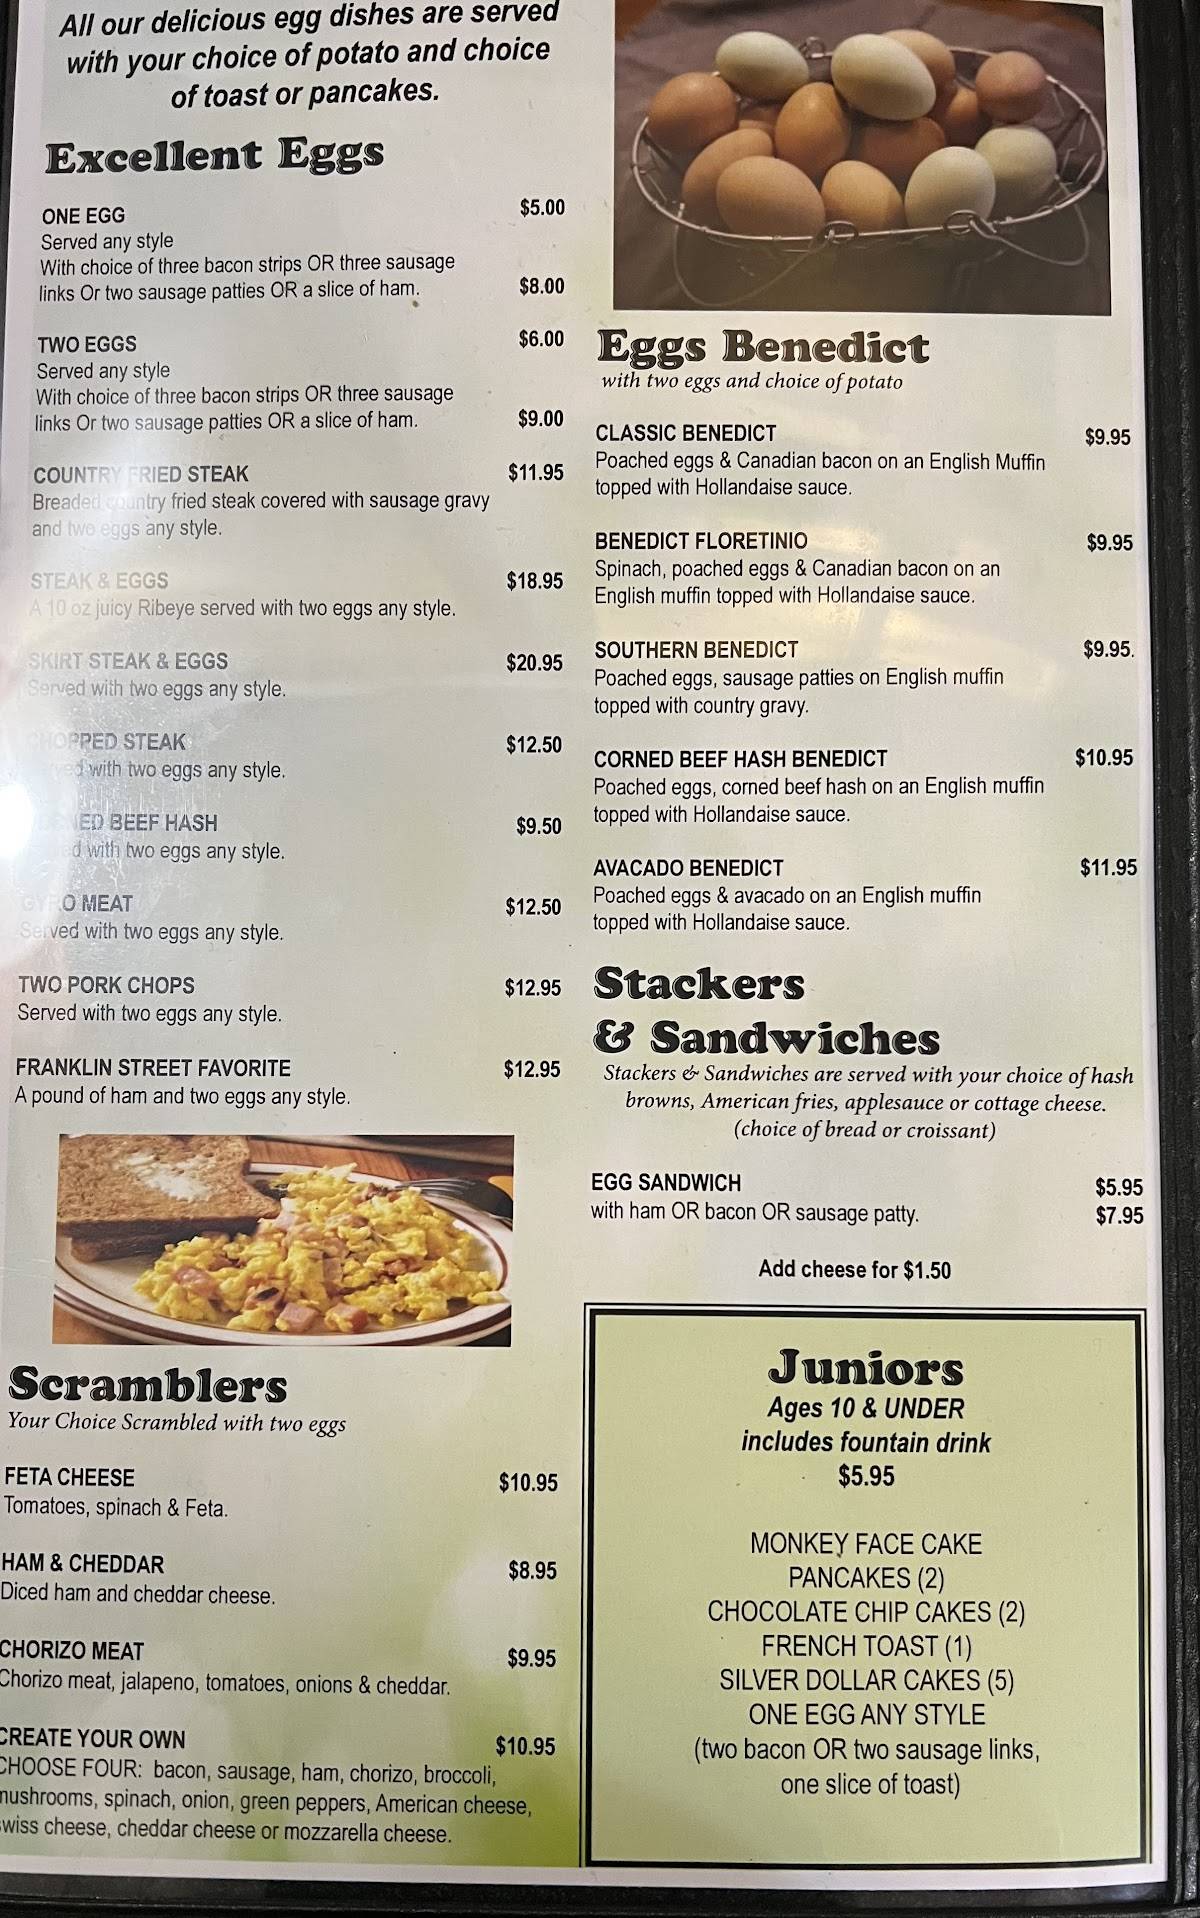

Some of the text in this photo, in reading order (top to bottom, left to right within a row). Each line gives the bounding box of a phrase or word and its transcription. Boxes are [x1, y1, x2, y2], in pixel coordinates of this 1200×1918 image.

[59, 0, 560, 37] All our delicious egg dishes are served
[68, 37, 550, 78] with your choice of potato and choice
[171, 78, 438, 110] of toast or pancakes.
[45, 136, 384, 175] Excellent Eggs
[43, 207, 124, 224] ONE EGG
[521, 198, 565, 217] $5.00
[42, 232, 173, 253] Served any style
[41, 254, 454, 276] With choice of three bacon strips OR three sausage
[520, 277, 564, 296] $8.00
[38, 336, 136, 353] TWO EGGS
[519, 329, 564, 348] $6.00
[597, 329, 930, 370] Eggs Benedict
[602, 372, 903, 395] with two eggs and choice of potato
[519, 409, 563, 429] $9.00
[596, 424, 776, 441] CLASSIC BENEDICT
[1086, 427, 1130, 447] $9.95
[509, 463, 563, 482] $11.95
[596, 532, 807, 549] BENEDICT FLORETINIO
[1088, 533, 1133, 552] $9.95
[507, 571, 563, 591] $18.95
[595, 641, 798, 658] SOUTHERN BENEDICT
[1084, 640, 1134, 659] $9.95.
[507, 653, 563, 673] $20.95
[595, 696, 808, 718] topped with country gravy.
[507, 735, 562, 754] $12.50
[595, 750, 888, 768] CORNED BEEF HASH BENEDICT
[1076, 748, 1133, 768] $10.95
[517, 816, 561, 836] $9.50
[594, 859, 784, 876] AVACADO BENEDICT
[1081, 858, 1137, 877] $11.95
[506, 897, 561, 917] $12.50
[19, 976, 194, 994] TWO PORK CHOPS
[505, 978, 561, 998] $12.95
[594, 966, 804, 999] Stackers
[18, 1003, 281, 1026] Served with two eggs any style.
[593, 1019, 939, 1055] & Sandwiches
[17, 1058, 290, 1076] FRANKLIN STREET FAVORITE
[504, 1059, 560, 1079] $12.95
[735, 1119, 995, 1142] (choice of bread or croissant)
[592, 1173, 740, 1191] EGG SANDWICH
[1096, 1177, 1143, 1198] $5.95
[1097, 1205, 1143, 1226] $7.95
[759, 1259, 951, 1281] Add cheese for $1.50
[768, 1349, 963, 1386] Juniors
[9, 1366, 287, 1403] Scramblers
[767, 1396, 964, 1423] Ages 10 & UNDER
[742, 1430, 992, 1453] includes fountain drink
[5, 1467, 134, 1487] FETA CHEESE
[500, 1472, 558, 1493] $10.95
[839, 1463, 894, 1488] $5.95
[4, 1495, 227, 1520] Tomatoes, spinach & Feta.
[752, 1532, 982, 1554] MONKEY FACE CAKE
[2, 1553, 164, 1573] HAM & CHEDDAR
[509, 1560, 557, 1581] $8.95
[790, 1567, 944, 1594] PANCAKES (2)
[709, 1600, 1024, 1628] CHOCOLATE CHIP CAKES (2)
[0, 1640, 144, 1660] CHORIZO MEAT
[508, 1648, 556, 1669] $9.95
[763, 1635, 971, 1662] FRENCH TOAST (1)
[720, 1669, 1013, 1696] SILVER DOLLAR CAKES (5)
[0, 1727, 185, 1749] CREATE YOUR OWN
[496, 1735, 555, 1757] $10.95
